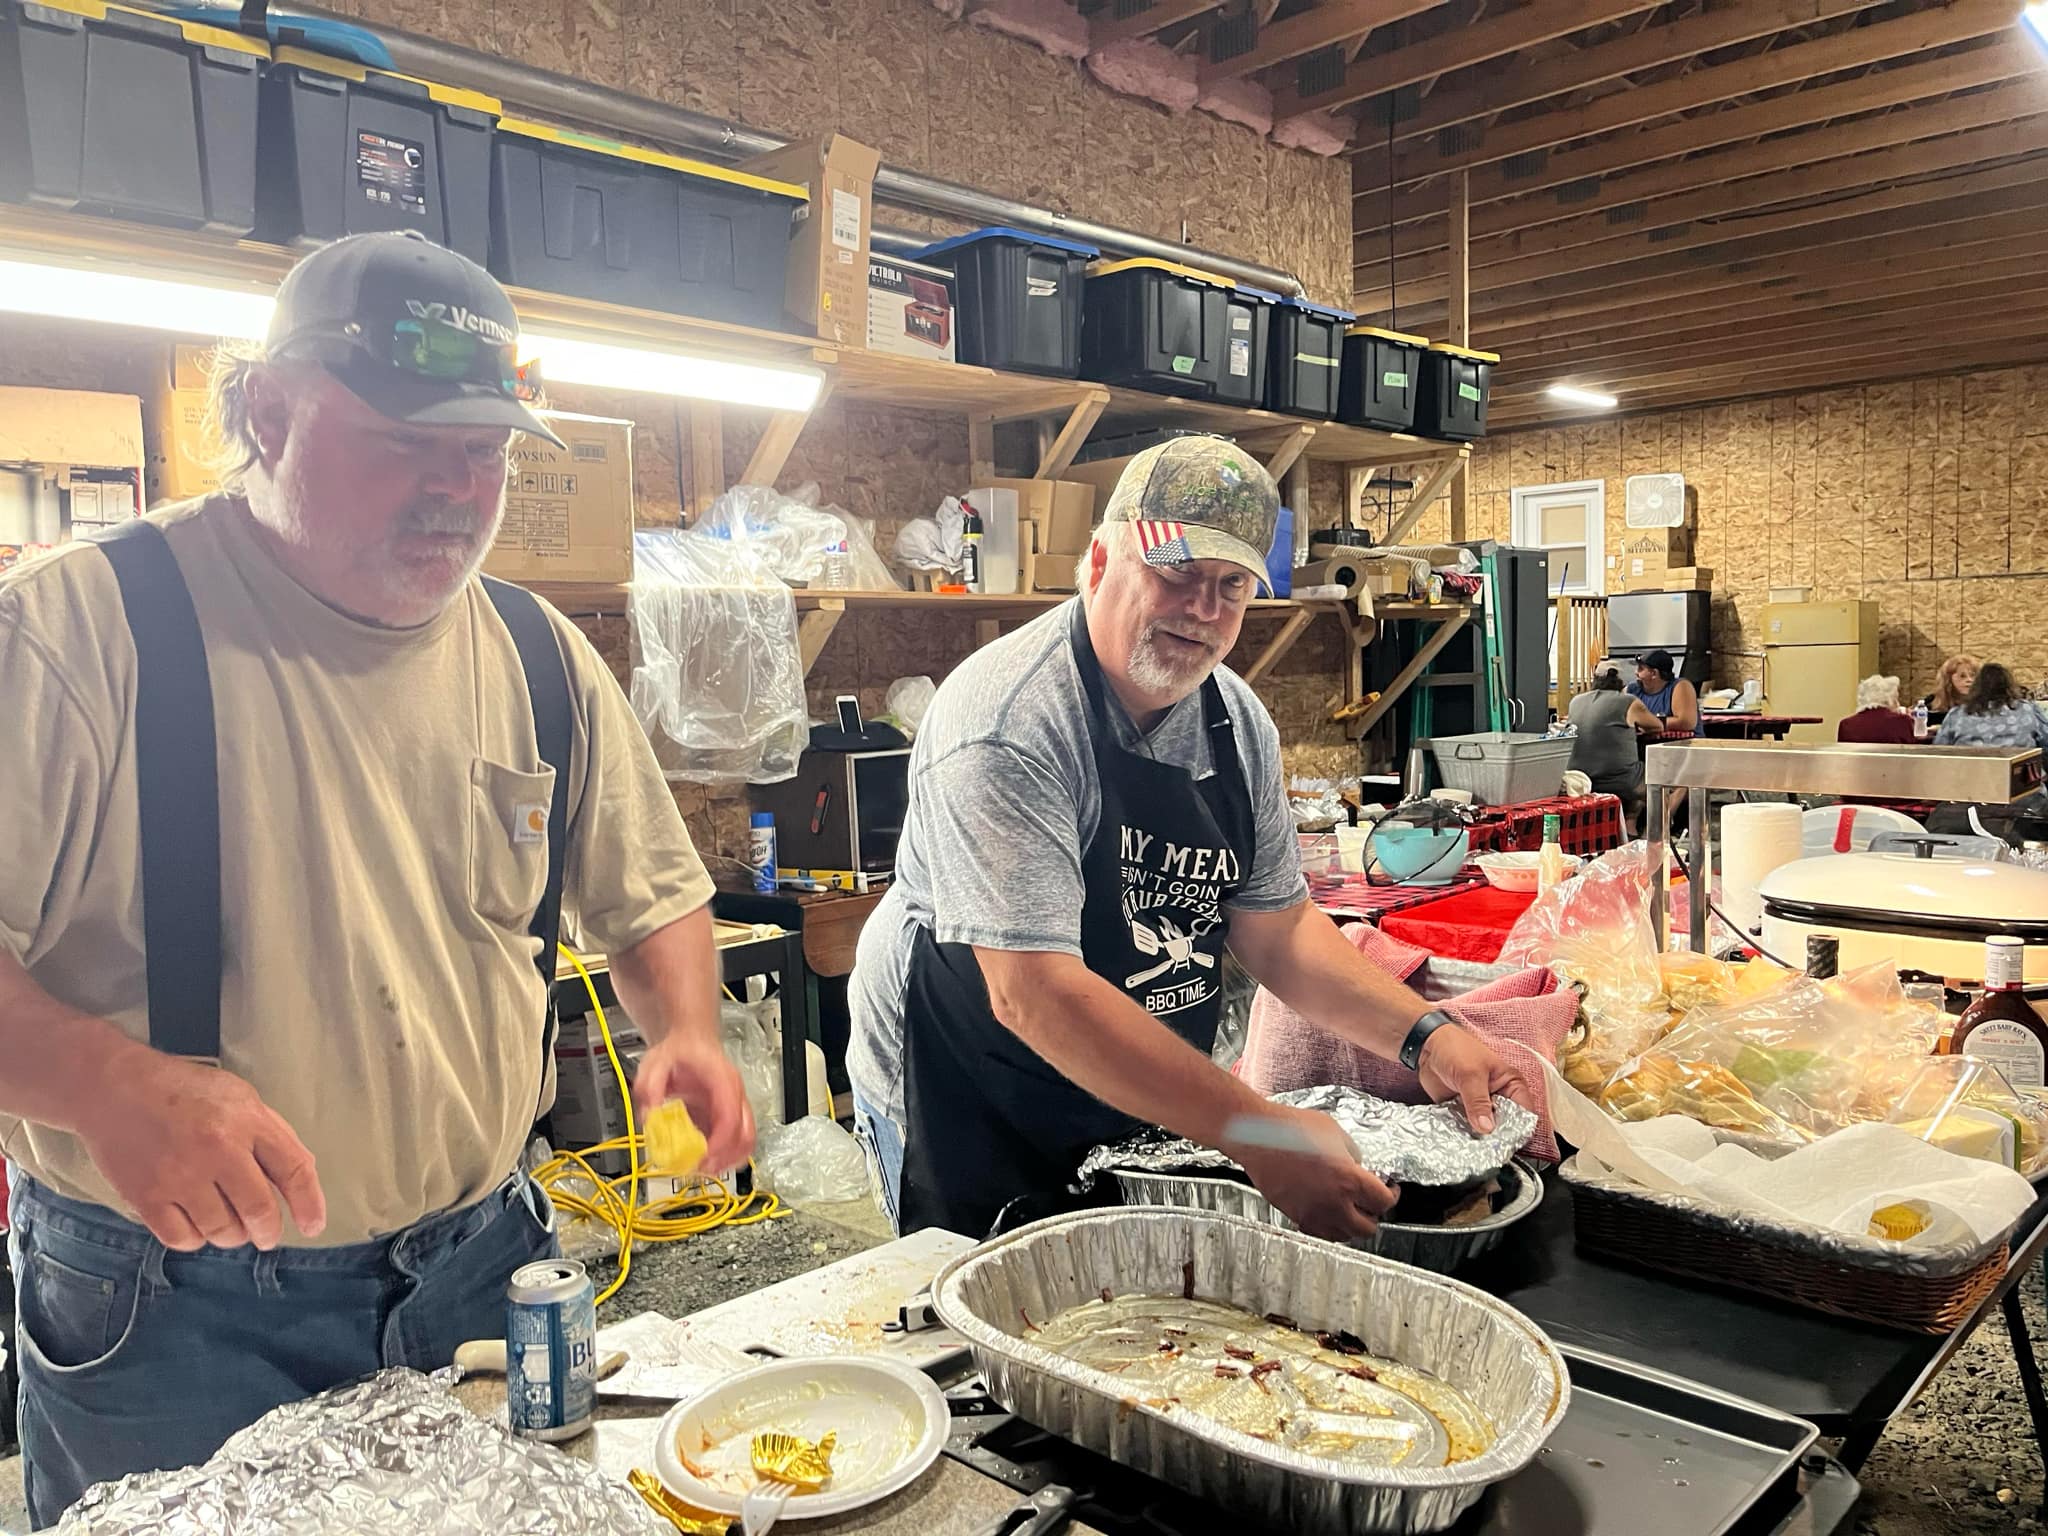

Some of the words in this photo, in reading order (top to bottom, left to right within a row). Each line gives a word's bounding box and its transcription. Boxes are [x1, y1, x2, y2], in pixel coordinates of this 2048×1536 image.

[1121, 825, 1154, 863] MY
[1169, 881, 1220, 900] GOIN
[1146, 992, 1177, 1012] BBQ
[1178, 981, 1207, 1005] TIME
